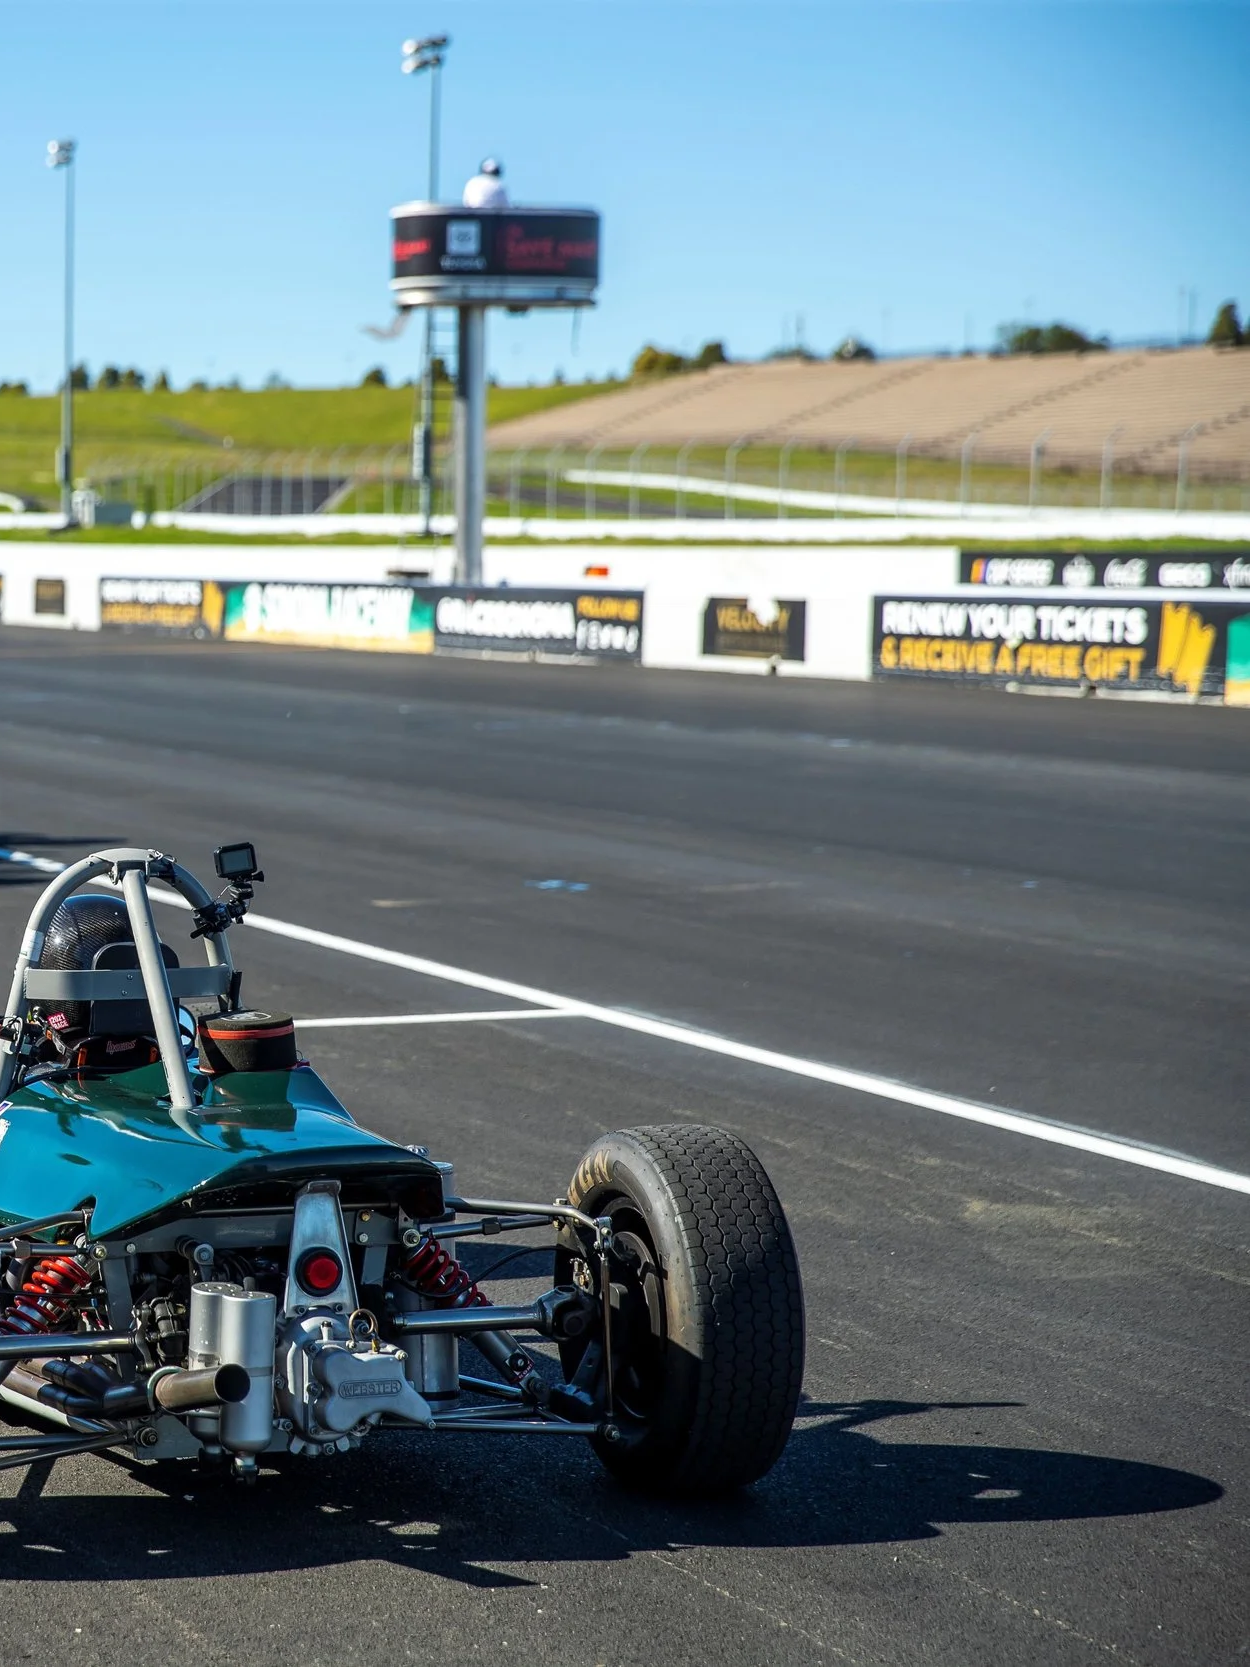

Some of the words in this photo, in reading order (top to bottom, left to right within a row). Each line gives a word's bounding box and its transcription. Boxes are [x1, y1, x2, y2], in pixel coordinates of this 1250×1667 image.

[882, 601, 967, 637] RENEW
[967, 603, 1036, 642] YOUR
[1035, 605, 1148, 645] TICKETS
[880, 634, 898, 669] &
[898, 636, 995, 674] RECEIVE
[995, 640, 1015, 676] A
[1015, 642, 1083, 680] FREE
[1083, 645, 1146, 683] GIFT
[341, 1380, 401, 1397] WEBSTER
